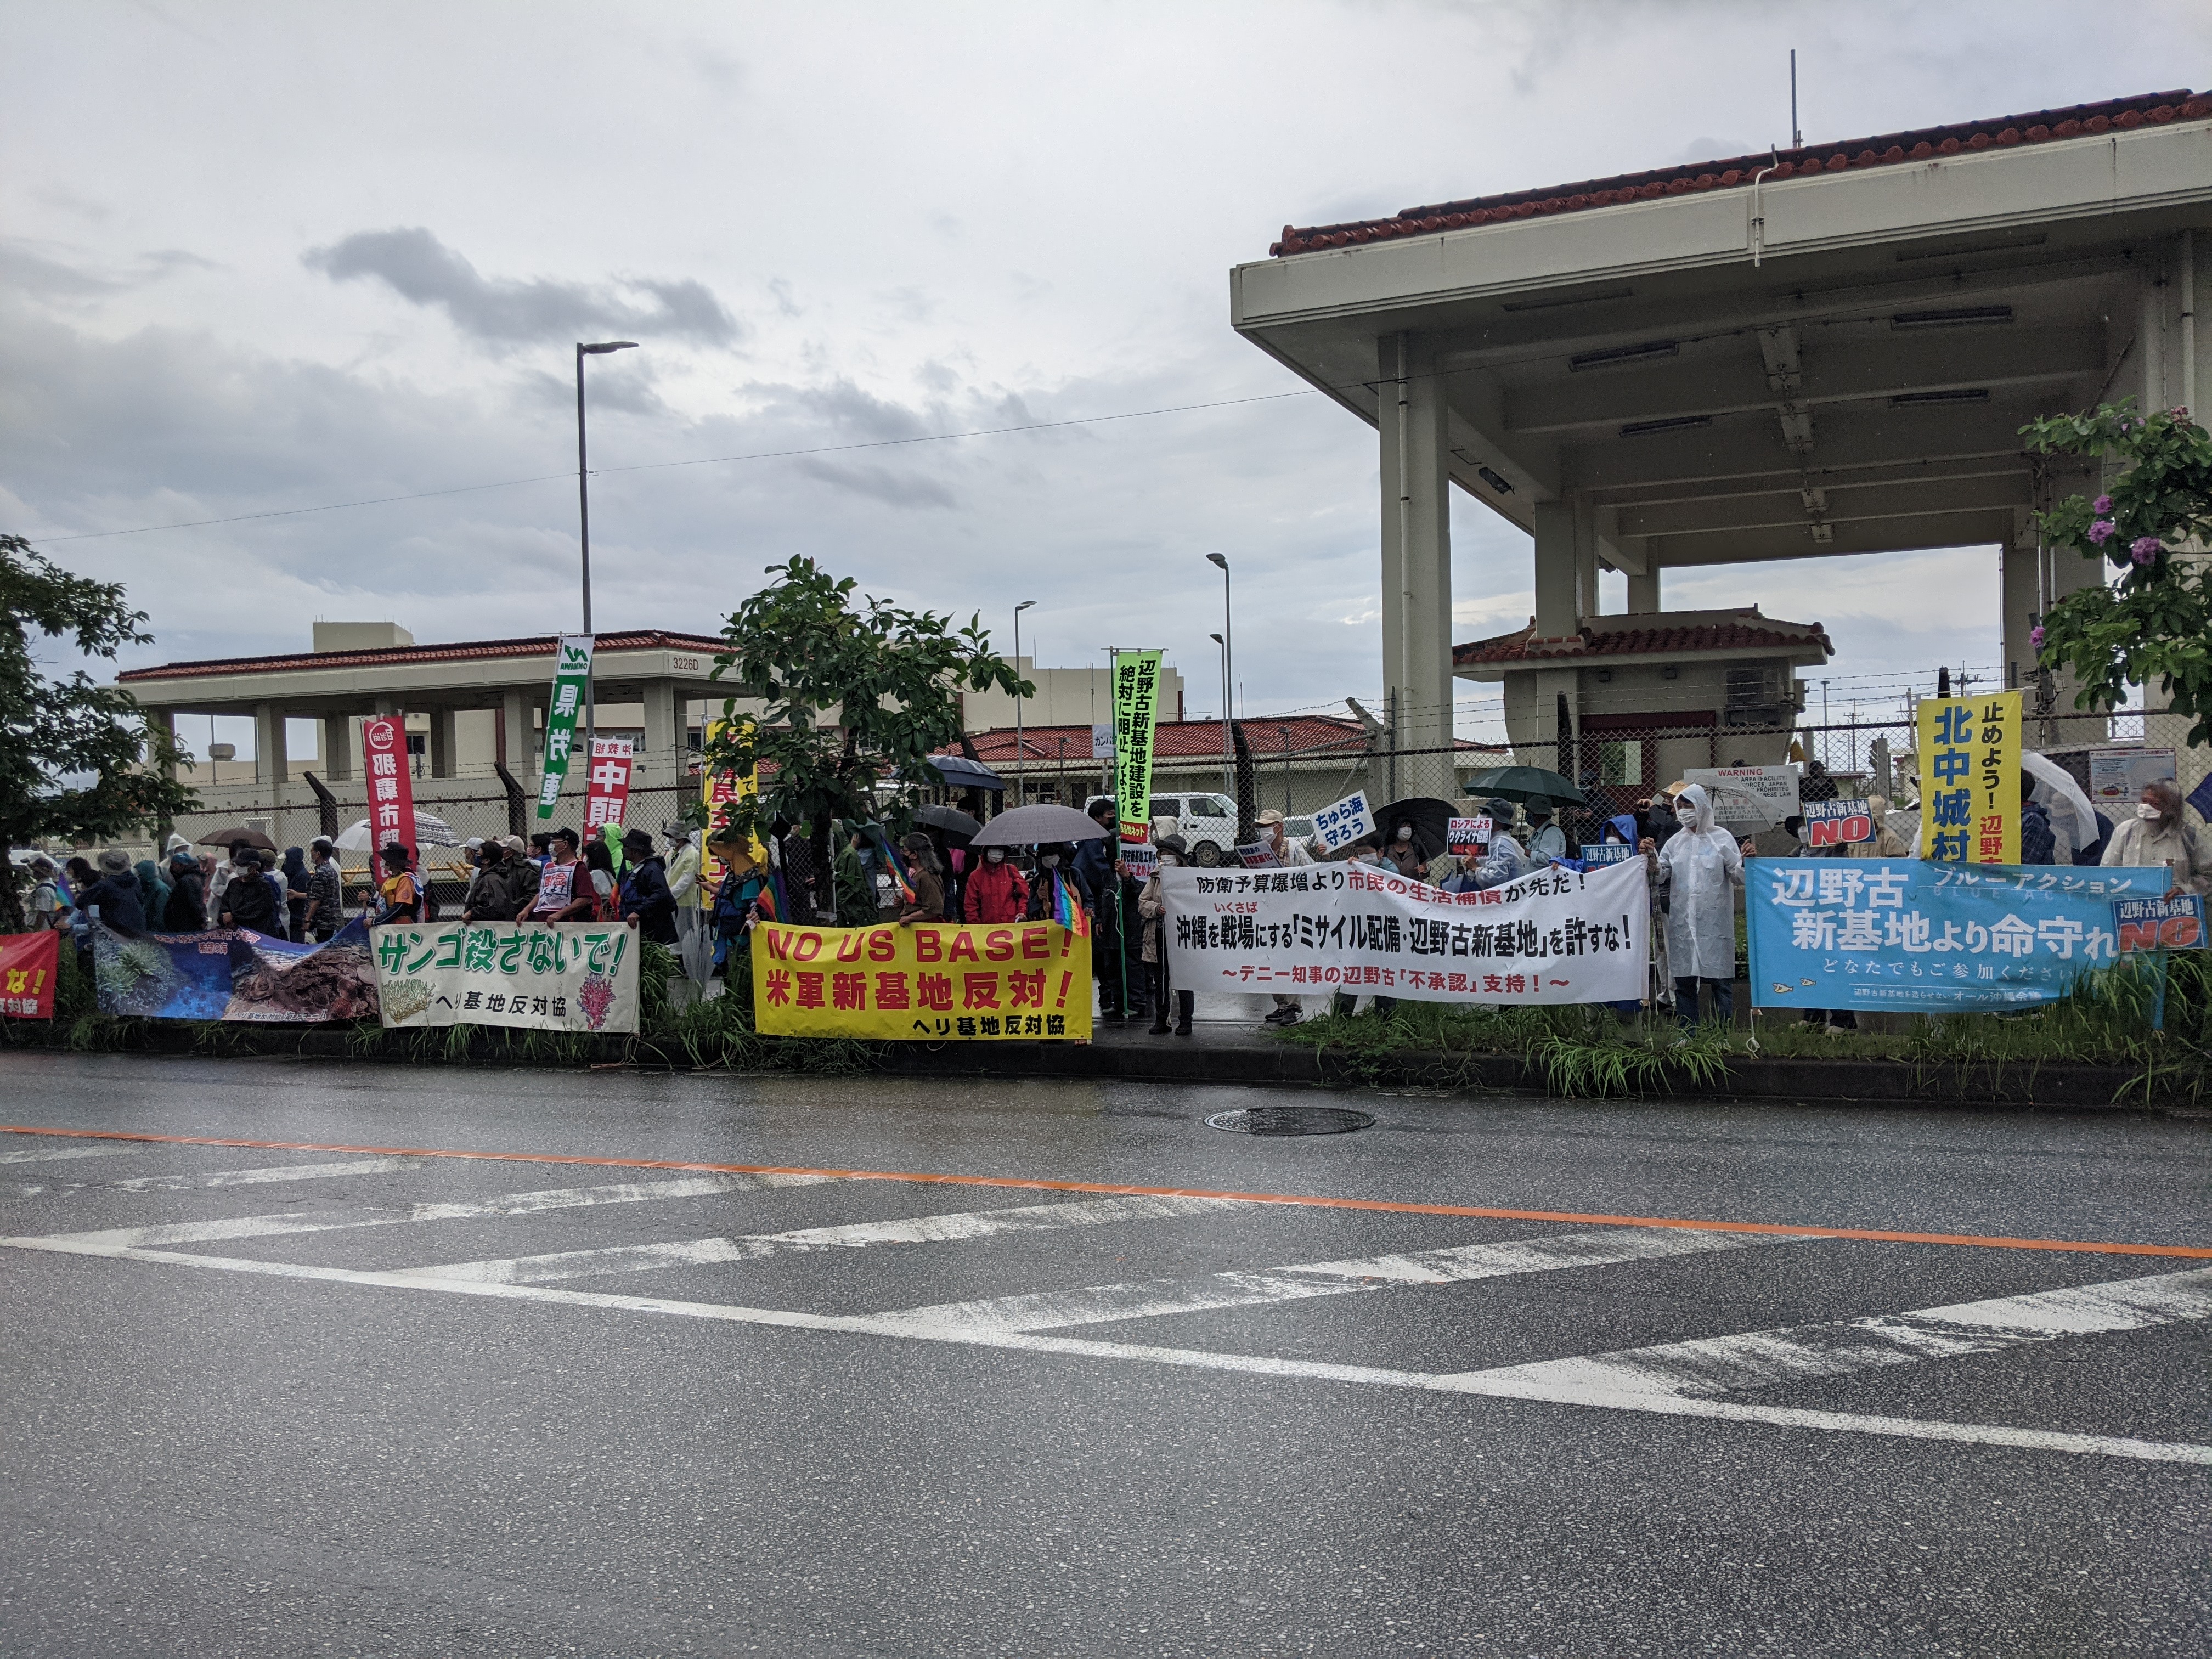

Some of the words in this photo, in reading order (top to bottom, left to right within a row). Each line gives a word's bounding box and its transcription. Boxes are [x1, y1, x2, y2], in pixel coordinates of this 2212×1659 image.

[674, 657, 699, 670] 3226D
[1118, 665, 1136, 817] 絶対に阻止しよう！
[1130, 659, 1156, 817] 辺野古新基地建設を
[1718, 769, 1763, 777] WARNING
[1932, 706, 1974, 862] 北中城村
[1315, 795, 1364, 831] ちゅら海
[1805, 799, 1869, 818] 辺野古新基地
[1325, 817, 1364, 847] 守ろう
[1449, 830, 1489, 844] ウクライナ侵略
[1451, 819, 1490, 829] ロシアによる
[1811, 815, 1871, 847] NO
[1585, 847, 1630, 862] 辺野古新基地
[1196, 870, 1585, 906] 防衛予算爆増より市民の生活補償が先だ！
[1771, 867, 1909, 908] 辺野古
[1934, 867, 2132, 894] ブルーアクション
[1214, 901, 1259, 913] いくさば
[2120, 898, 2194, 919] 辺野古新基地
[199, 941, 228, 955] 希望の海
[768, 929, 822, 962] NO
[837, 929, 896, 962] US
[1792, 909, 2120, 960] 新基地より命守れ
[2119, 916, 2200, 953] NO
[378, 927, 627, 976] サンゴ殺さないで！
[1824, 958, 2073, 981] どなたでもご参加ください
[436, 990, 567, 1017] ヘリ基地反対協
[766, 968, 1073, 1012] 米軍新基地反対！
[912, 1014, 1065, 1037] ヘリ基地反対協
